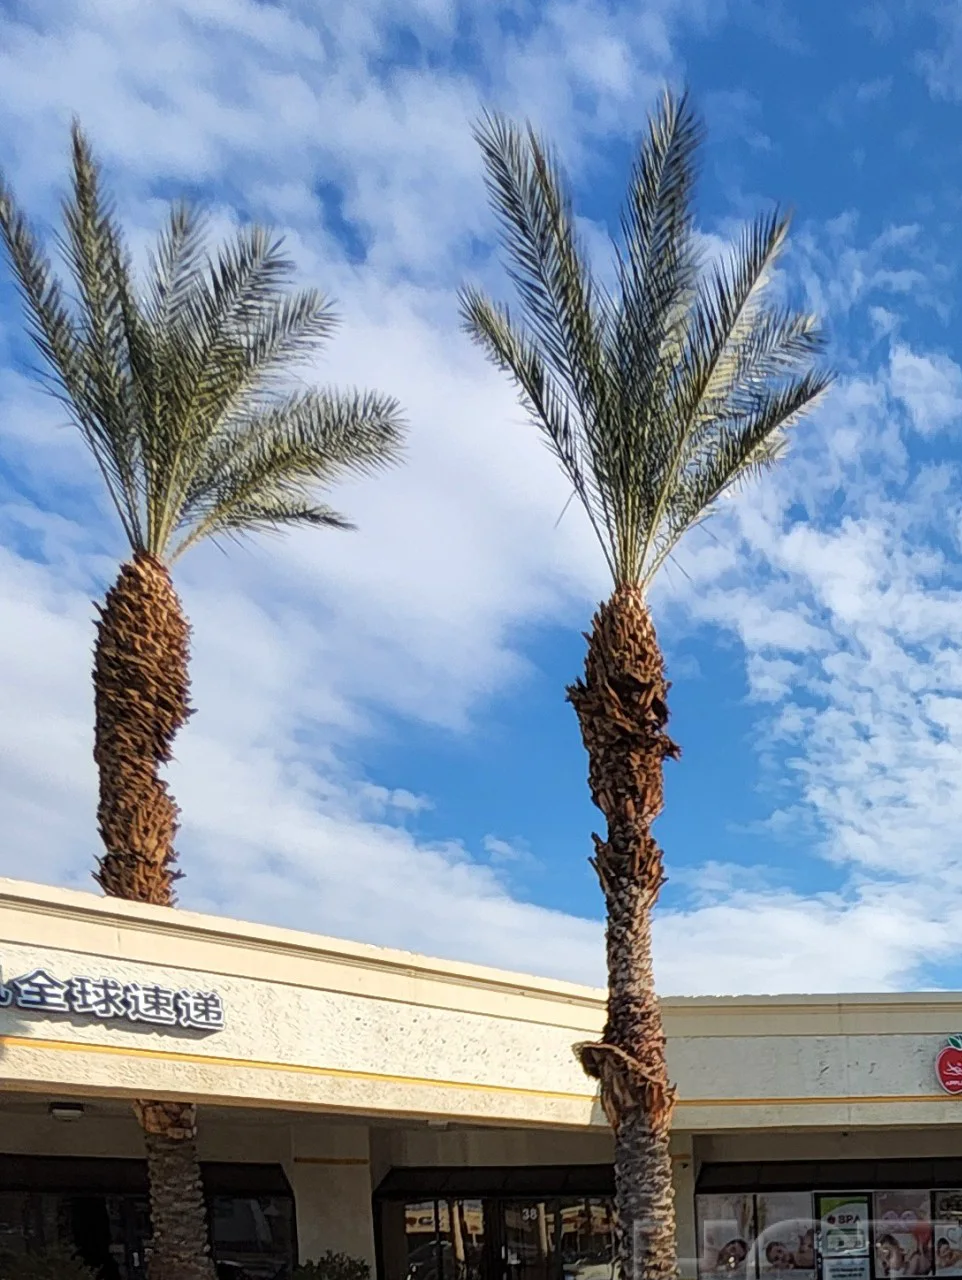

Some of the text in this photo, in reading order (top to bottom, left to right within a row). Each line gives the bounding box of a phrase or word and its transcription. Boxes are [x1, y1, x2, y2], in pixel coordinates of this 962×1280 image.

[0, 966, 225, 1030] 全球速递
[522, 1208, 538, 1221] 38
